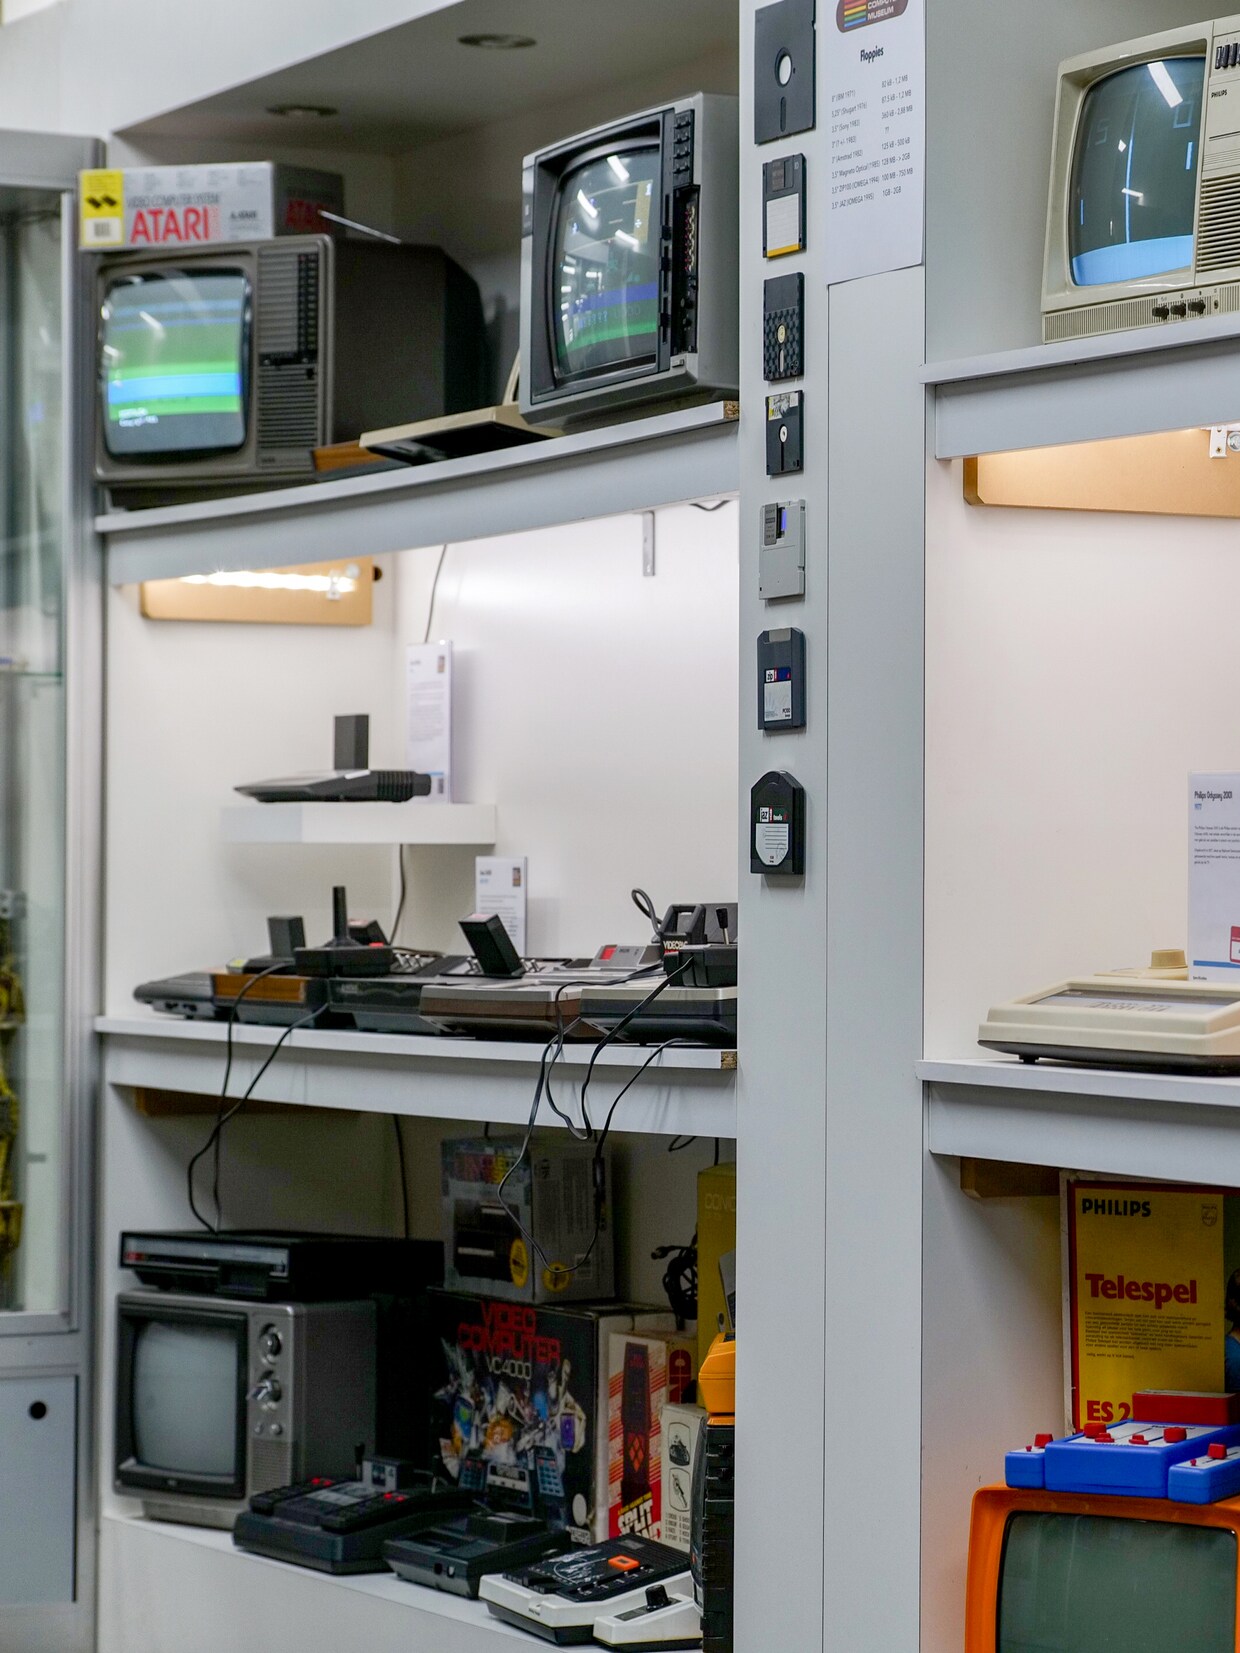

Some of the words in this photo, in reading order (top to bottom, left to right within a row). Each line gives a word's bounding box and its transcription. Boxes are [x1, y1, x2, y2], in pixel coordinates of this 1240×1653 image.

[867, 6, 894, 20] MUSEUM
[860, 45, 883, 64] Floppies
[1211, 89, 1228, 98] PHILIPS
[130, 206, 210, 244] ATARI
[1194, 790, 1206, 801] Philips
[1207, 791, 1223, 801] Odyssey
[1082, 1198, 1151, 1217] PHILIPS
[1085, 1273, 1197, 1309] Telespel
[481, 1299, 537, 1336] VIDEO
[457, 1321, 561, 1368] COMPUTER
[1086, 1400, 1114, 1422] ES
[618, 1498, 653, 1535] SPLIT
